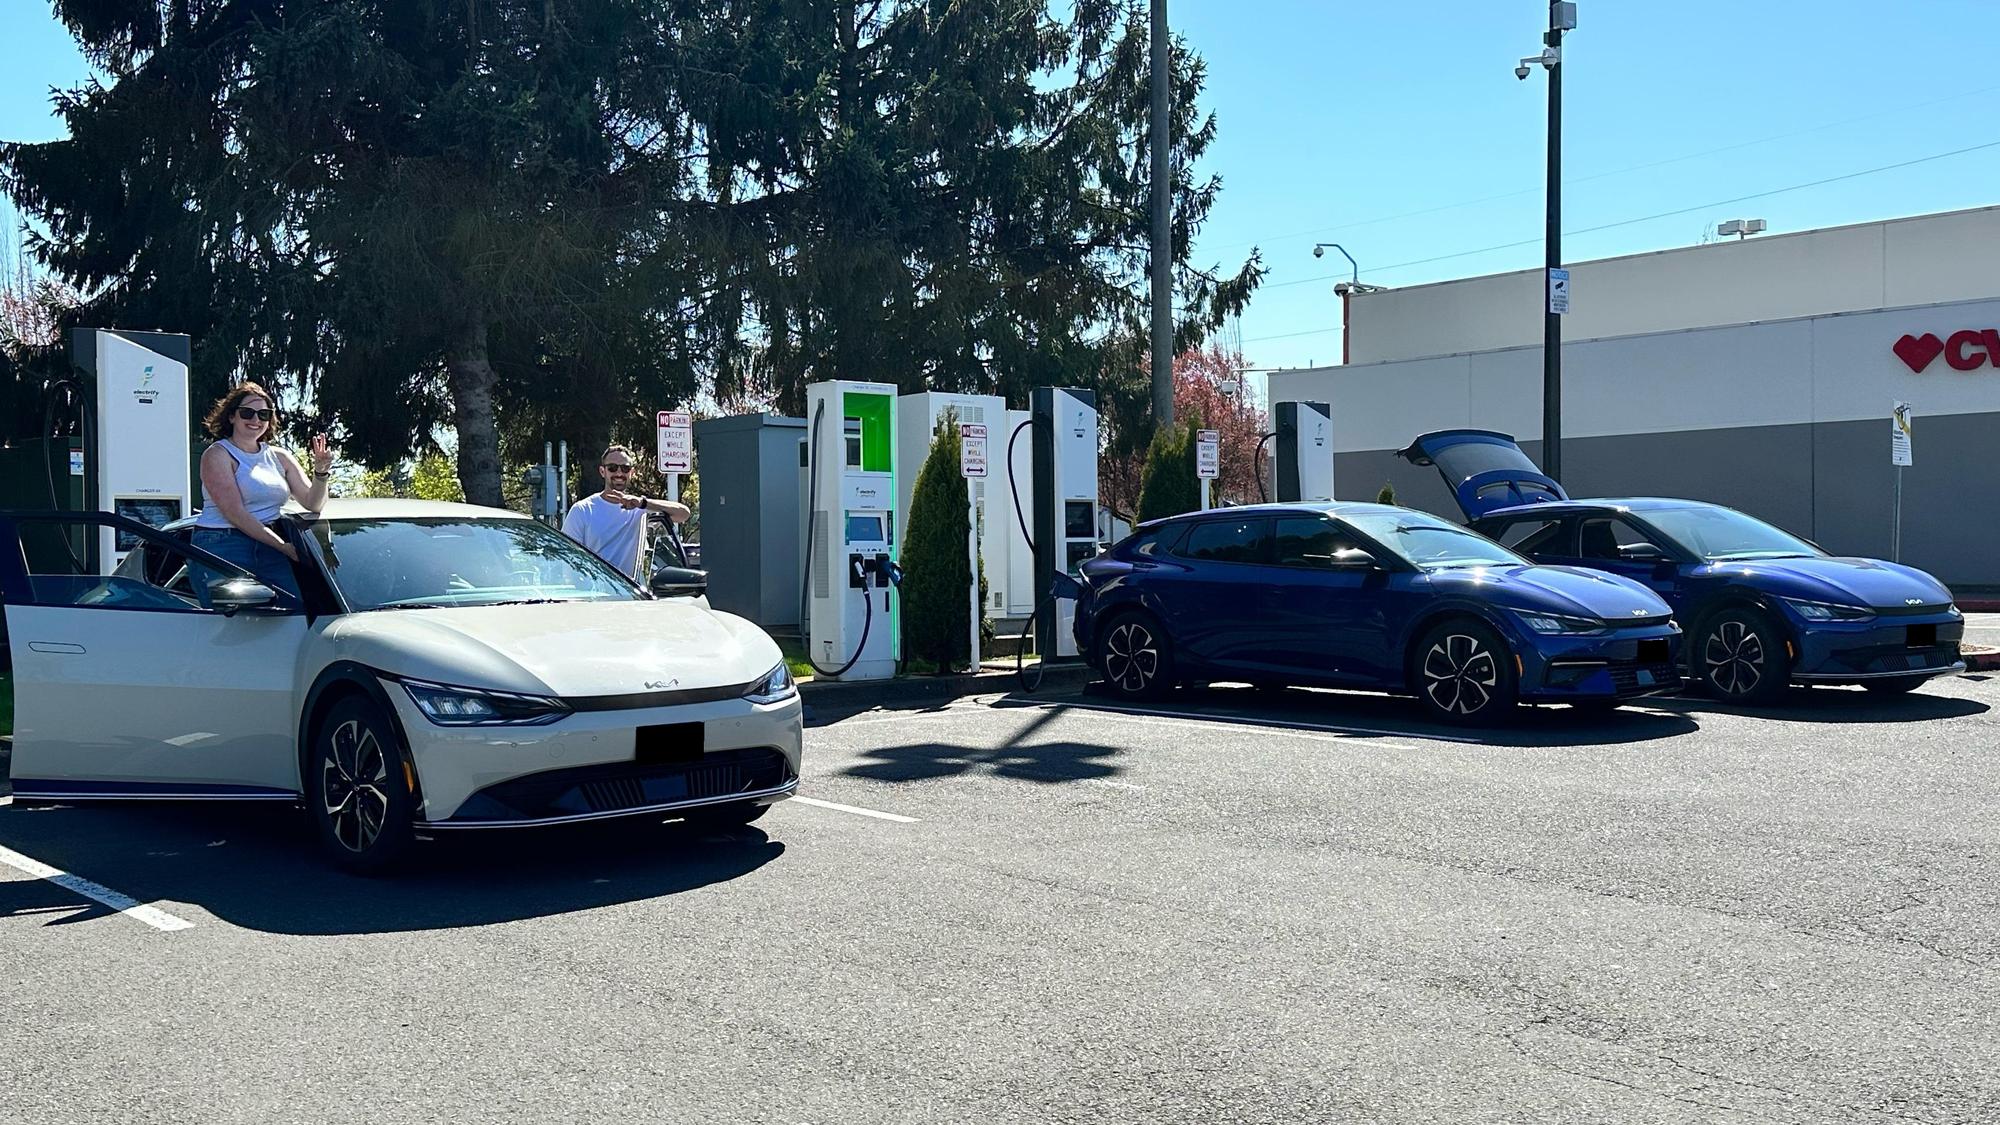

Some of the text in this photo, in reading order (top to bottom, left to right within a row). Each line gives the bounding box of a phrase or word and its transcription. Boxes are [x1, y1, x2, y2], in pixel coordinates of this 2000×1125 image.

[133, 389, 159, 397] electrify
[660, 415, 690, 425] NO PARKING
[664, 431, 686, 439] EXCEPT
[667, 441, 683, 449] WHILE
[661, 450, 689, 459] CHARGING
